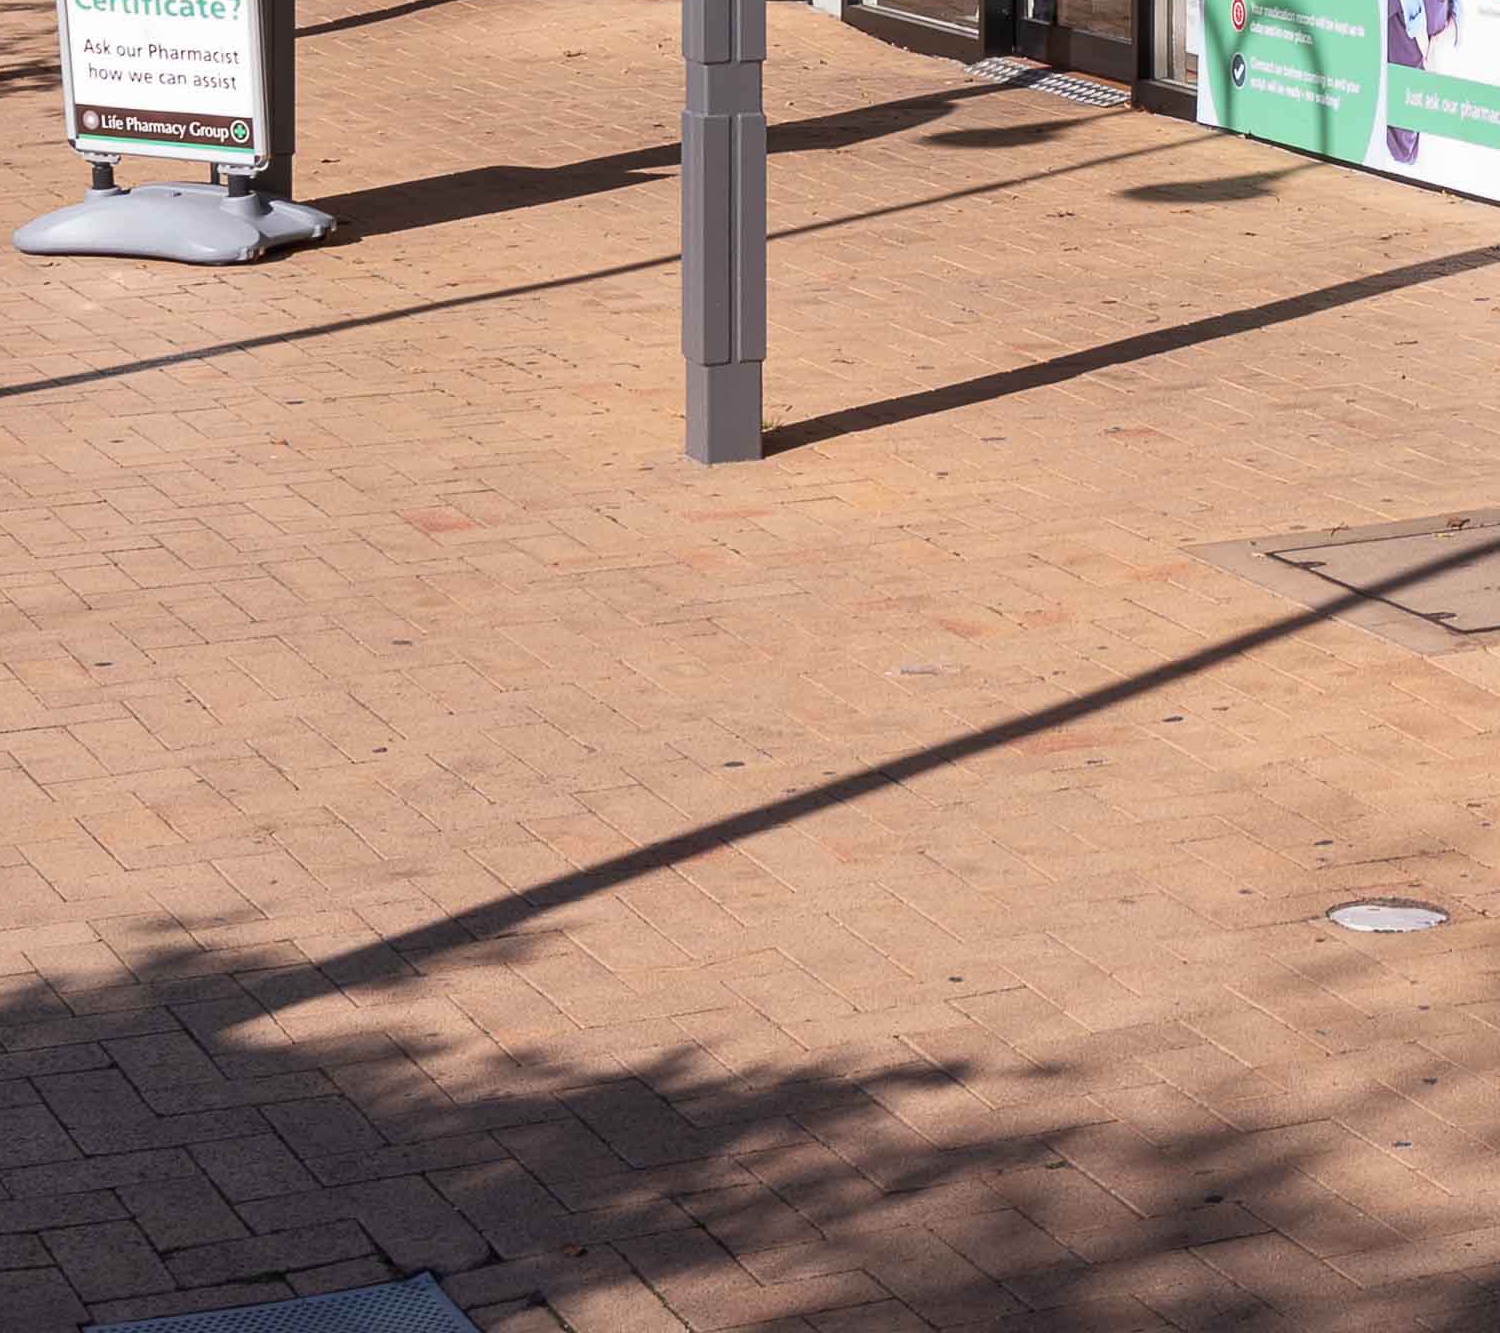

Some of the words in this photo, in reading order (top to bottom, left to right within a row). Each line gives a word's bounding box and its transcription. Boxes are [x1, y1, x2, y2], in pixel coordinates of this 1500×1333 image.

[84, 39, 111, 56] Ask
[116, 44, 142, 59] our
[148, 43, 239, 65] Pharmacist
[88, 66, 122, 85] how
[128, 71, 153, 85] we
[159, 72, 187, 88] can
[193, 73, 237, 91] assist
[101, 114, 124, 131] Life
[126, 115, 187, 140] Pharmacy
[190, 120, 229, 142] Group
